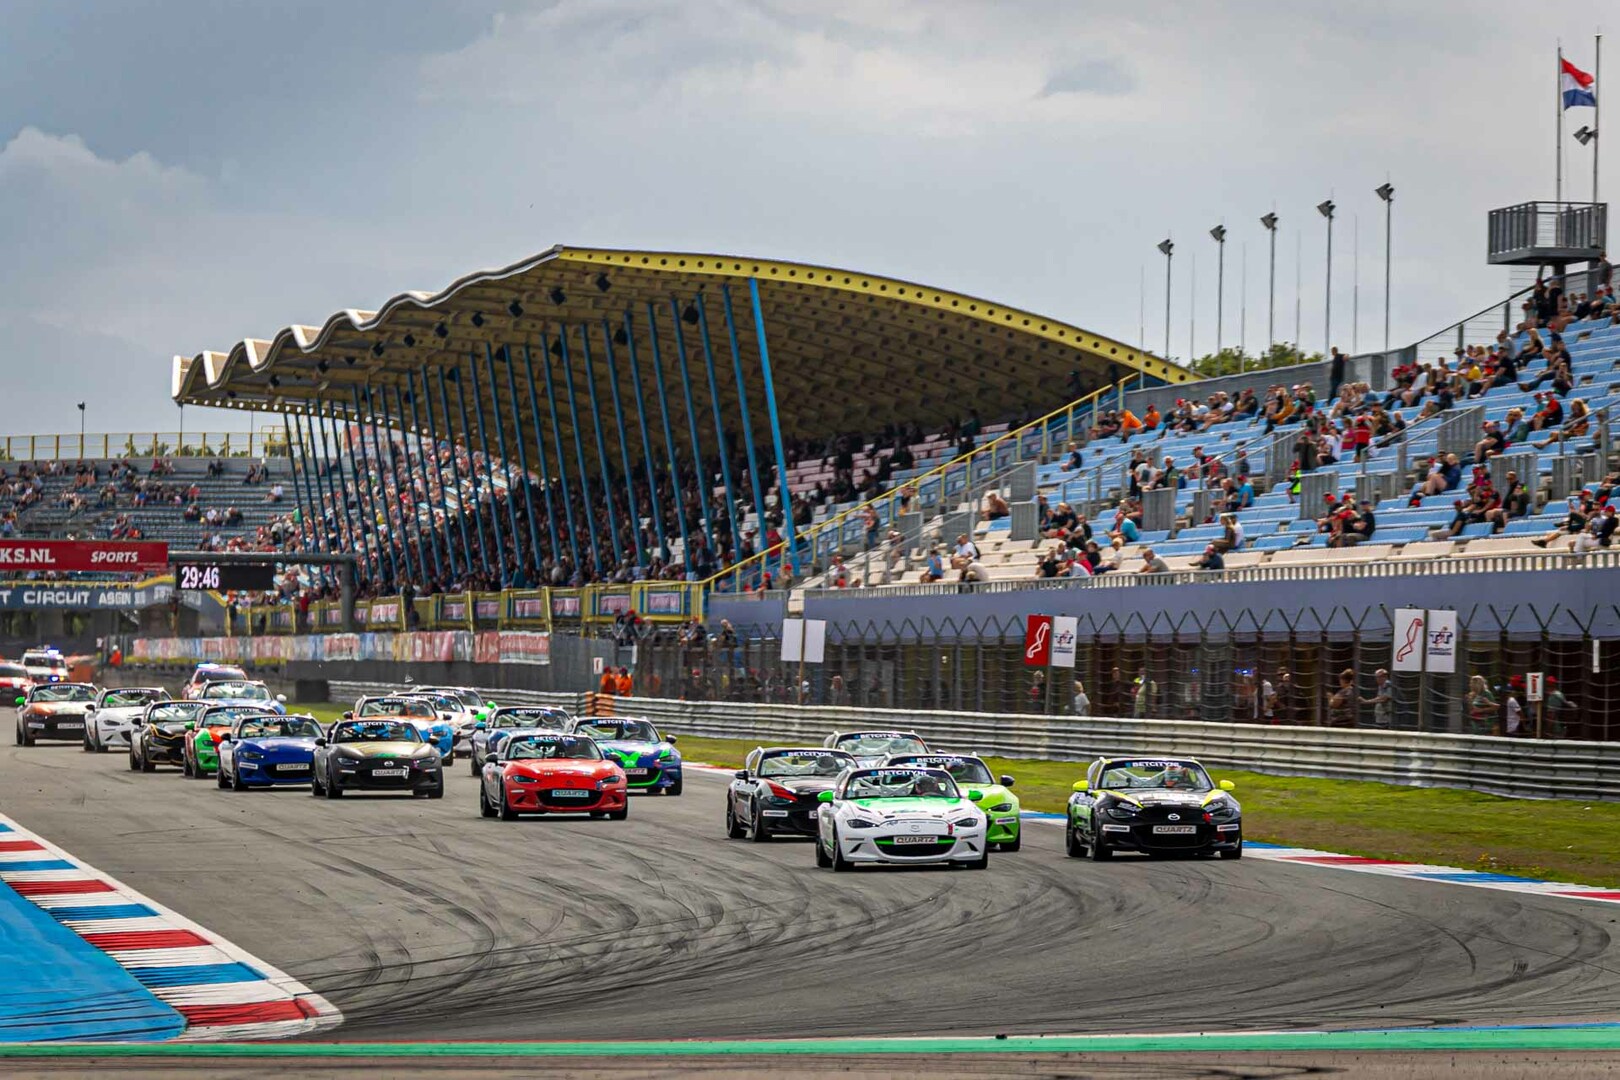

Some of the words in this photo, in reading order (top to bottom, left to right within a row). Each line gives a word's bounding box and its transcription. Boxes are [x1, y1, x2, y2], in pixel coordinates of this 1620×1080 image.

[90, 551, 138, 563] SPORTS
[181, 566, 220, 589] 29:46
[23, 591, 90, 605] CIRCUIT
[1155, 826, 1194, 834] QUARTZ
[896, 836, 936, 844] QUARTZ
